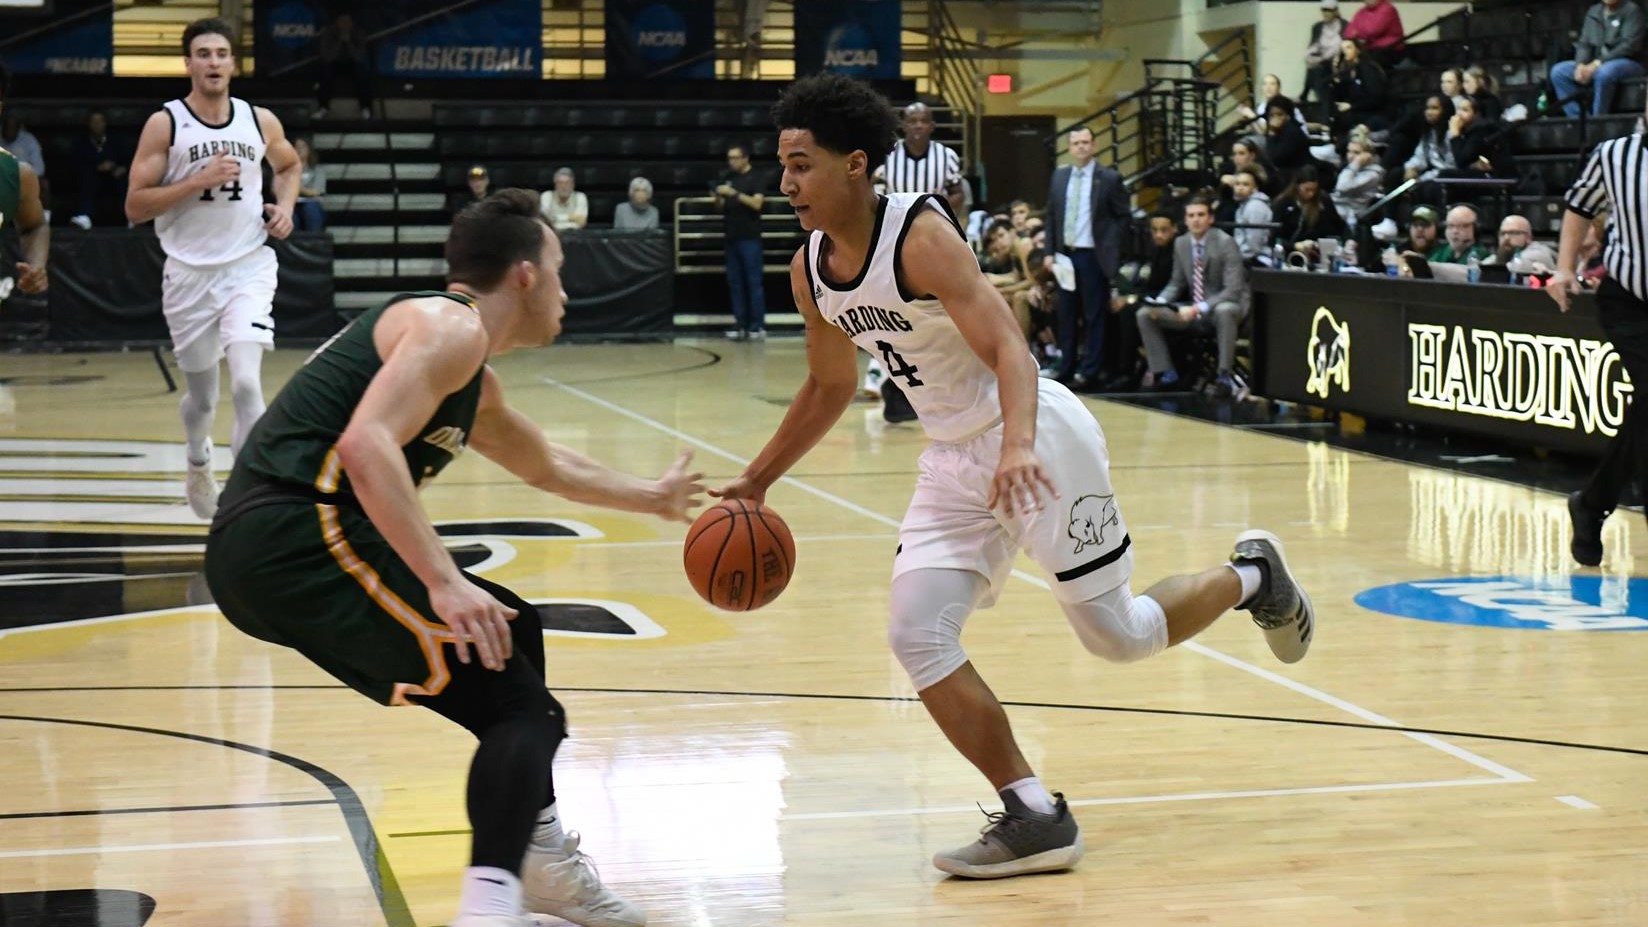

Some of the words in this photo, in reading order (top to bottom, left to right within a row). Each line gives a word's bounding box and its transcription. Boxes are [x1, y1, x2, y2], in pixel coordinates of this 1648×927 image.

[638, 31, 687, 47] NCAA
[393, 46, 534, 72] BASKETBALL
[823, 48, 878, 66] NCAA
[833, 305, 913, 338] ARDING
[875, 340, 924, 387] 4
[1408, 323, 1635, 437] HARDING
